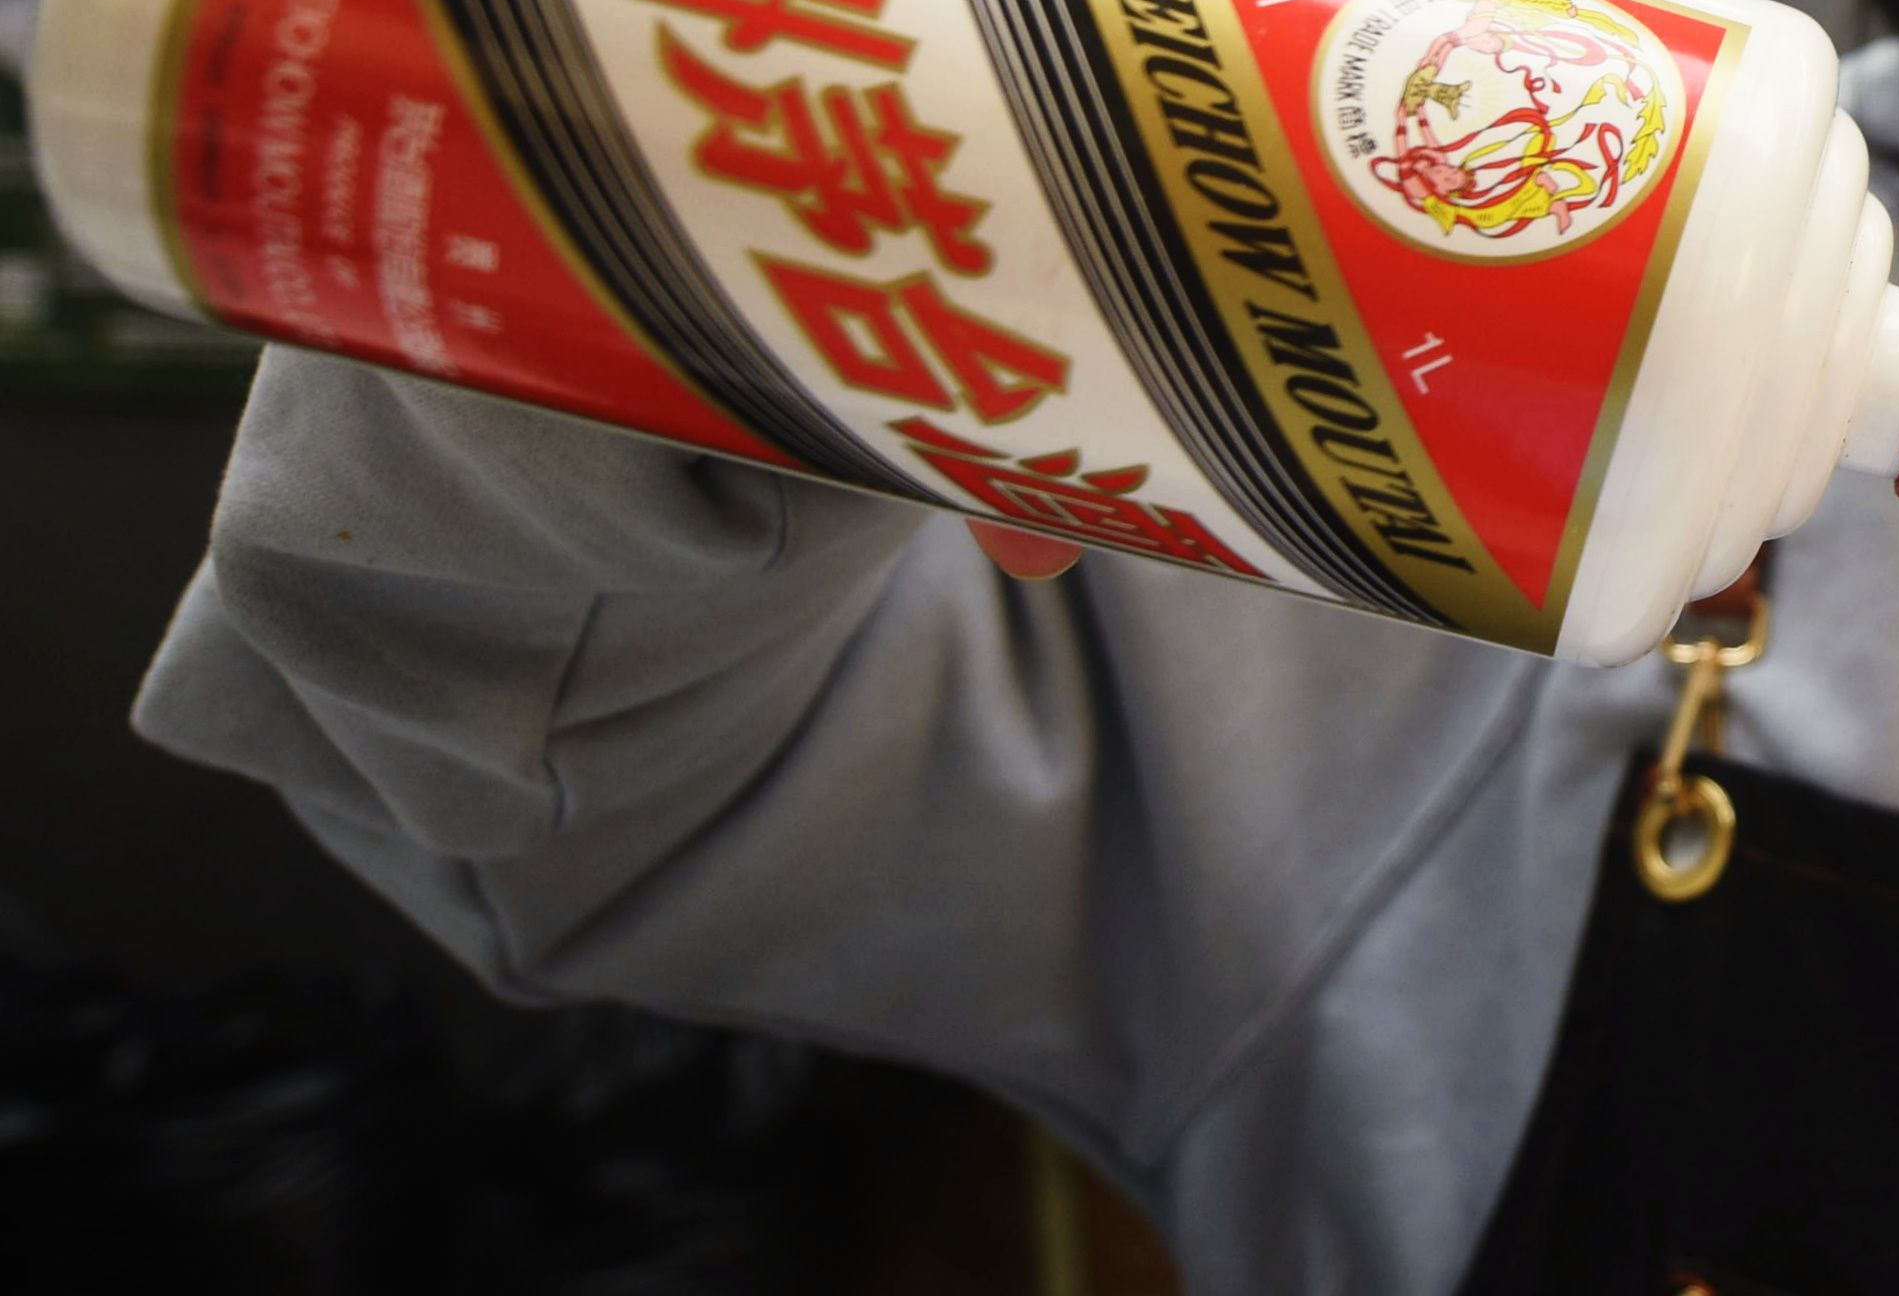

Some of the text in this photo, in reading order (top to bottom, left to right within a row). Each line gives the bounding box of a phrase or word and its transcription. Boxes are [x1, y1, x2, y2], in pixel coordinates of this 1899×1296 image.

[1334, 6, 1401, 103] TRADE MARK
[1402, 331, 1453, 395] 1L
[1248, 299, 1476, 575] MOUTAI
